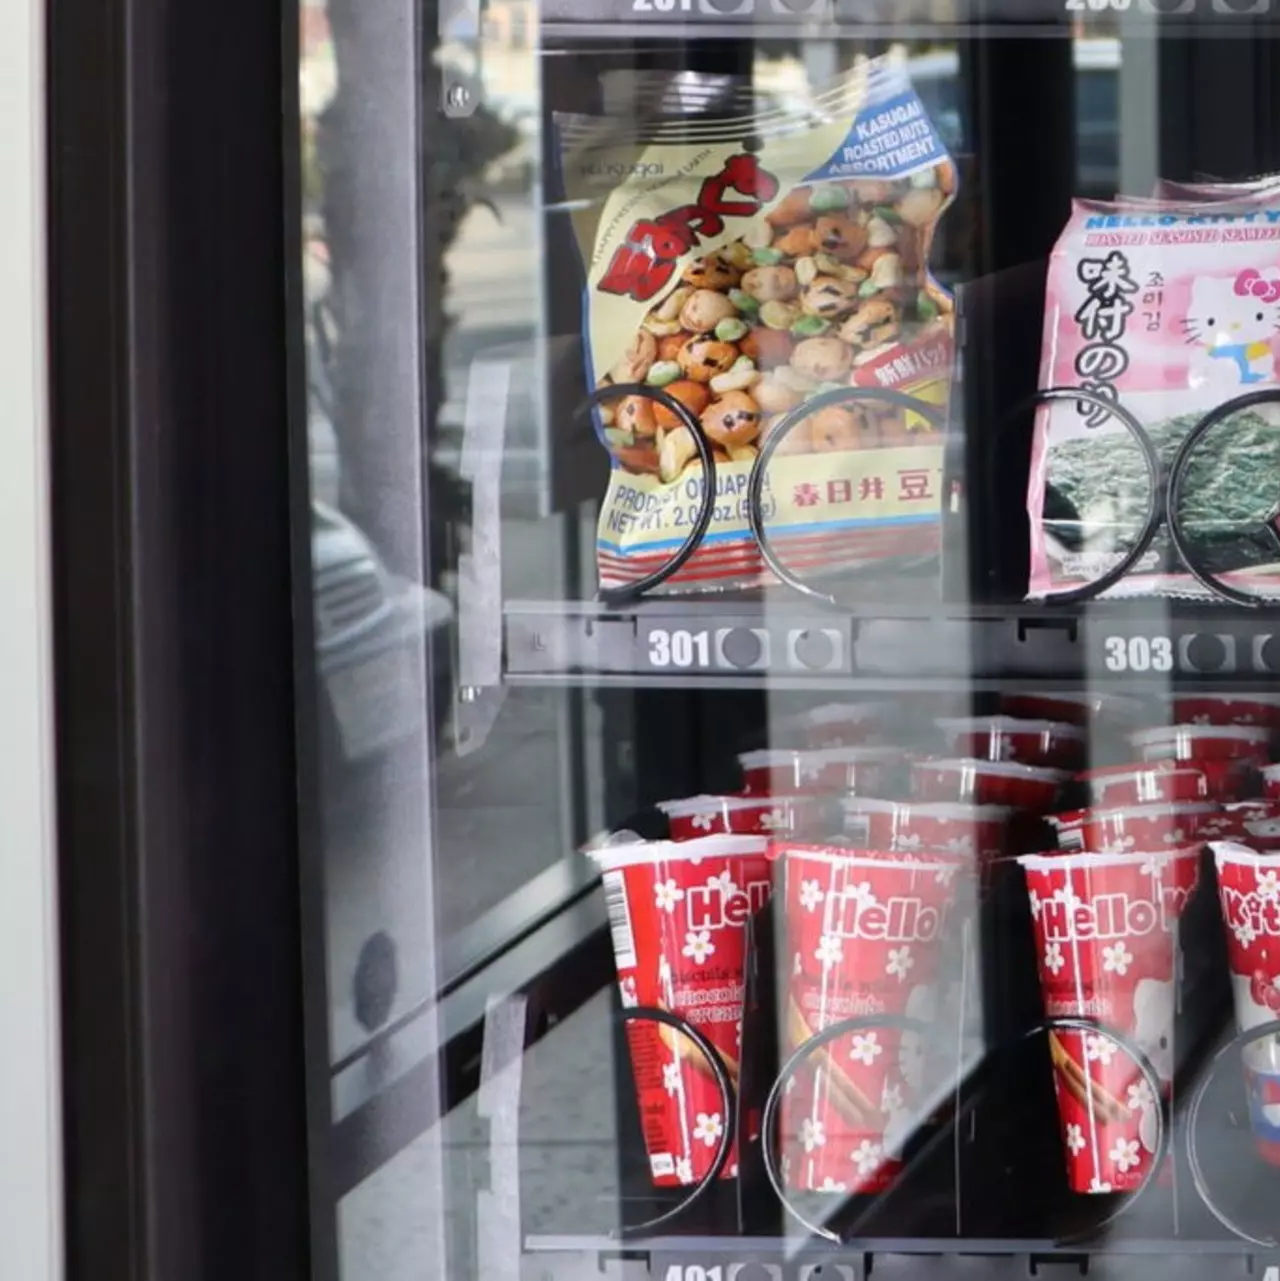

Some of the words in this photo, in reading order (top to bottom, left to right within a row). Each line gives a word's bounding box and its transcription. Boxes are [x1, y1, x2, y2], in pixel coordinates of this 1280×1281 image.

[856, 101, 922, 141] KASUGAI
[828, 135, 936, 175] ASSORTMENT
[843, 130, 900, 163] ROASTED
[648, 629, 710, 667] 301
[1105, 636, 1173, 672] 303
[686, 880, 770, 932] Hell
[827, 891, 940, 940] Hello
[1042, 891, 1158, 943] Hello
